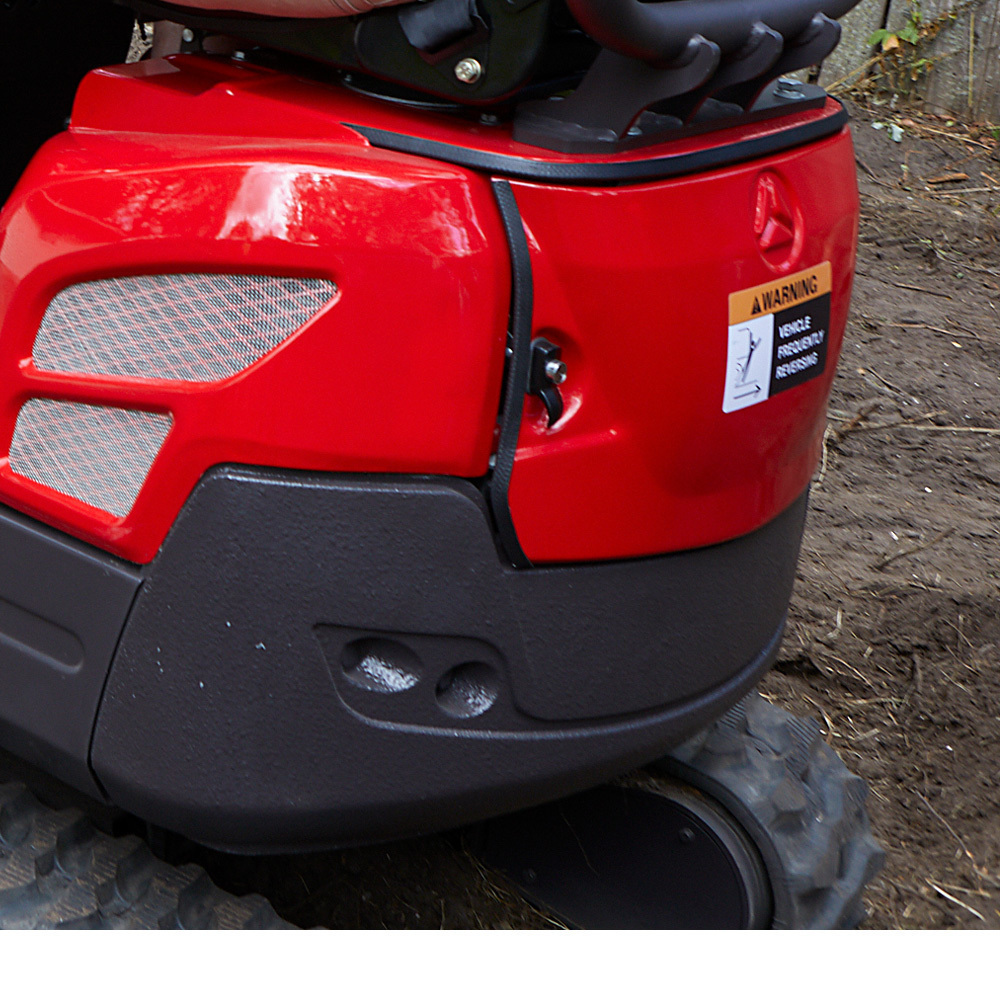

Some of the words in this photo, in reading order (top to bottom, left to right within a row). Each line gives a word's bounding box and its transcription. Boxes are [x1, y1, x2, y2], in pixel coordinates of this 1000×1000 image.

[761, 275, 818, 311] WARNING
[778, 315, 812, 339] VEHICLE
[777, 329, 825, 360] FREQUENTLY
[775, 352, 819, 380] REVERSING
